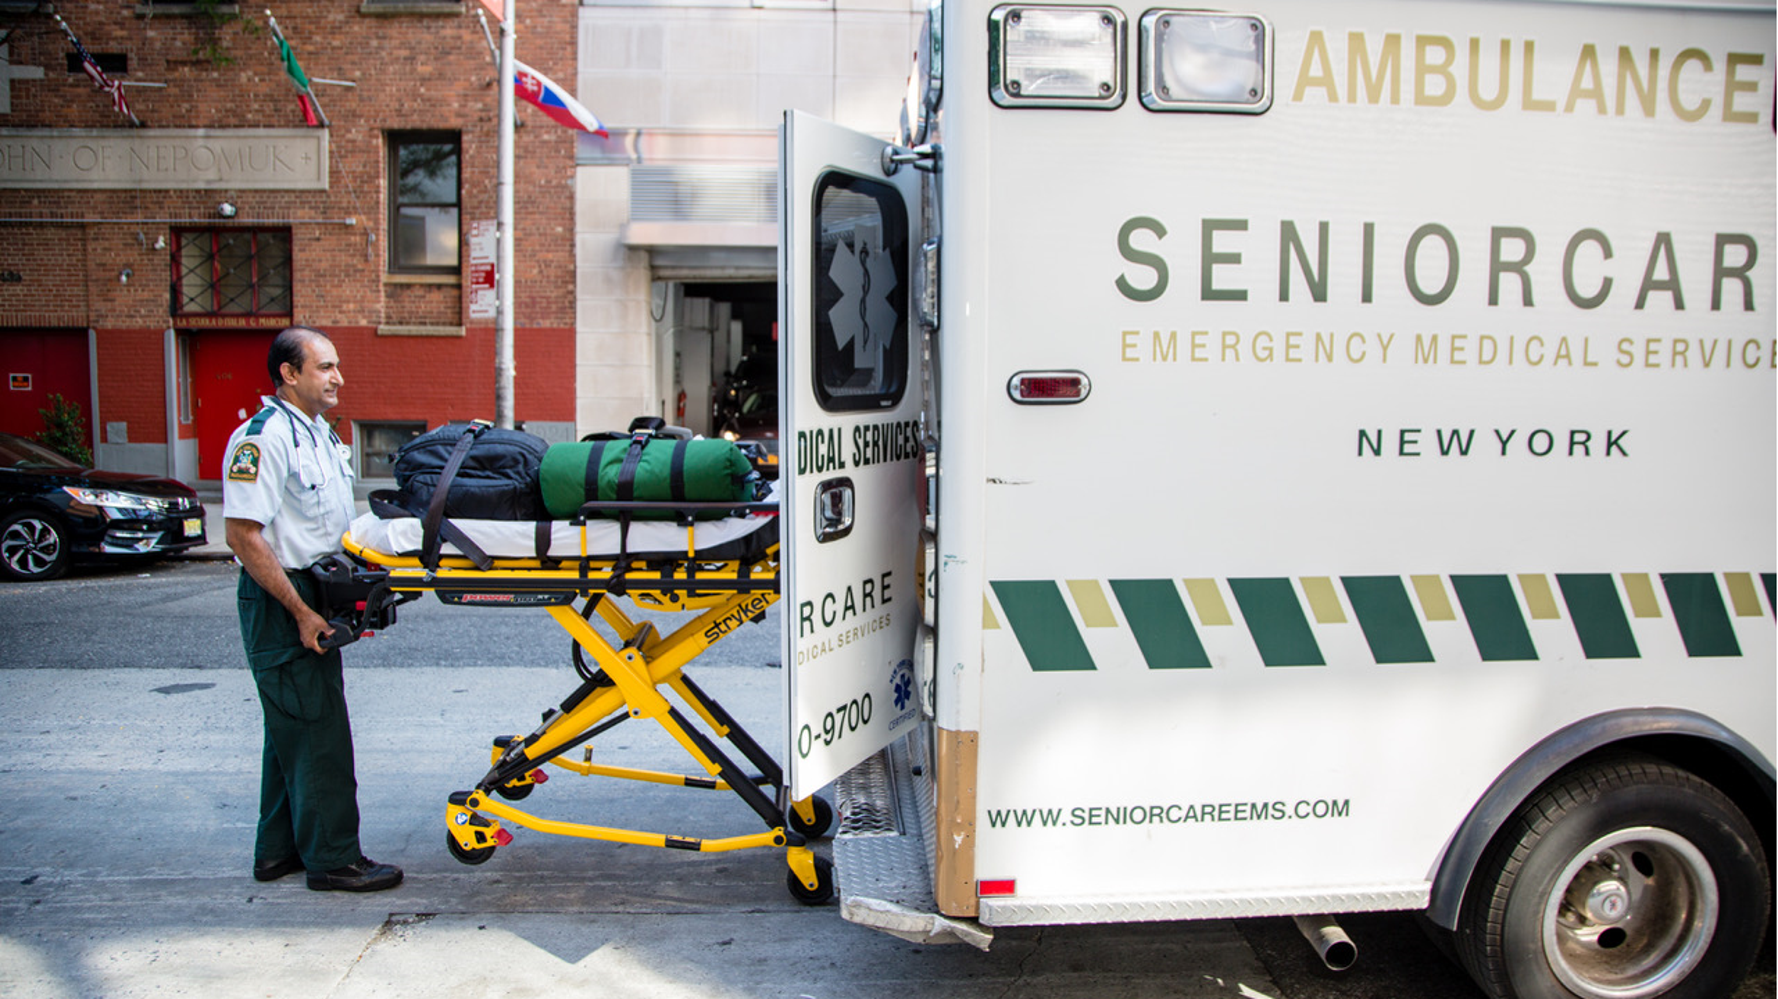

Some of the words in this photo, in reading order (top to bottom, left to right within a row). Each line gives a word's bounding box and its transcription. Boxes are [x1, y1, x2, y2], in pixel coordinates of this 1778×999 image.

[1292, 29, 1765, 125] AMBULANCE
[72, 145, 113, 171] OF
[128, 145, 295, 172] NEPOMUK
[1115, 216, 1758, 312] SENIORCAR
[1121, 330, 1396, 365] EMERGENCY
[1414, 333, 1600, 368] MEDICAL
[797, 426, 846, 477] DICAL
[852, 419, 920, 468] SERVICES
[1356, 427, 1477, 458] NEW
[1492, 427, 1630, 458] YORK
[704, 592, 772, 645] stryker
[799, 569, 893, 639] RCARE
[797, 641, 834, 666] DICAL
[838, 612, 891, 649] SERVICES
[798, 691, 873, 759] 0-9700
[987, 798, 1351, 829] WWW.SENIORCAREEMS.COM
